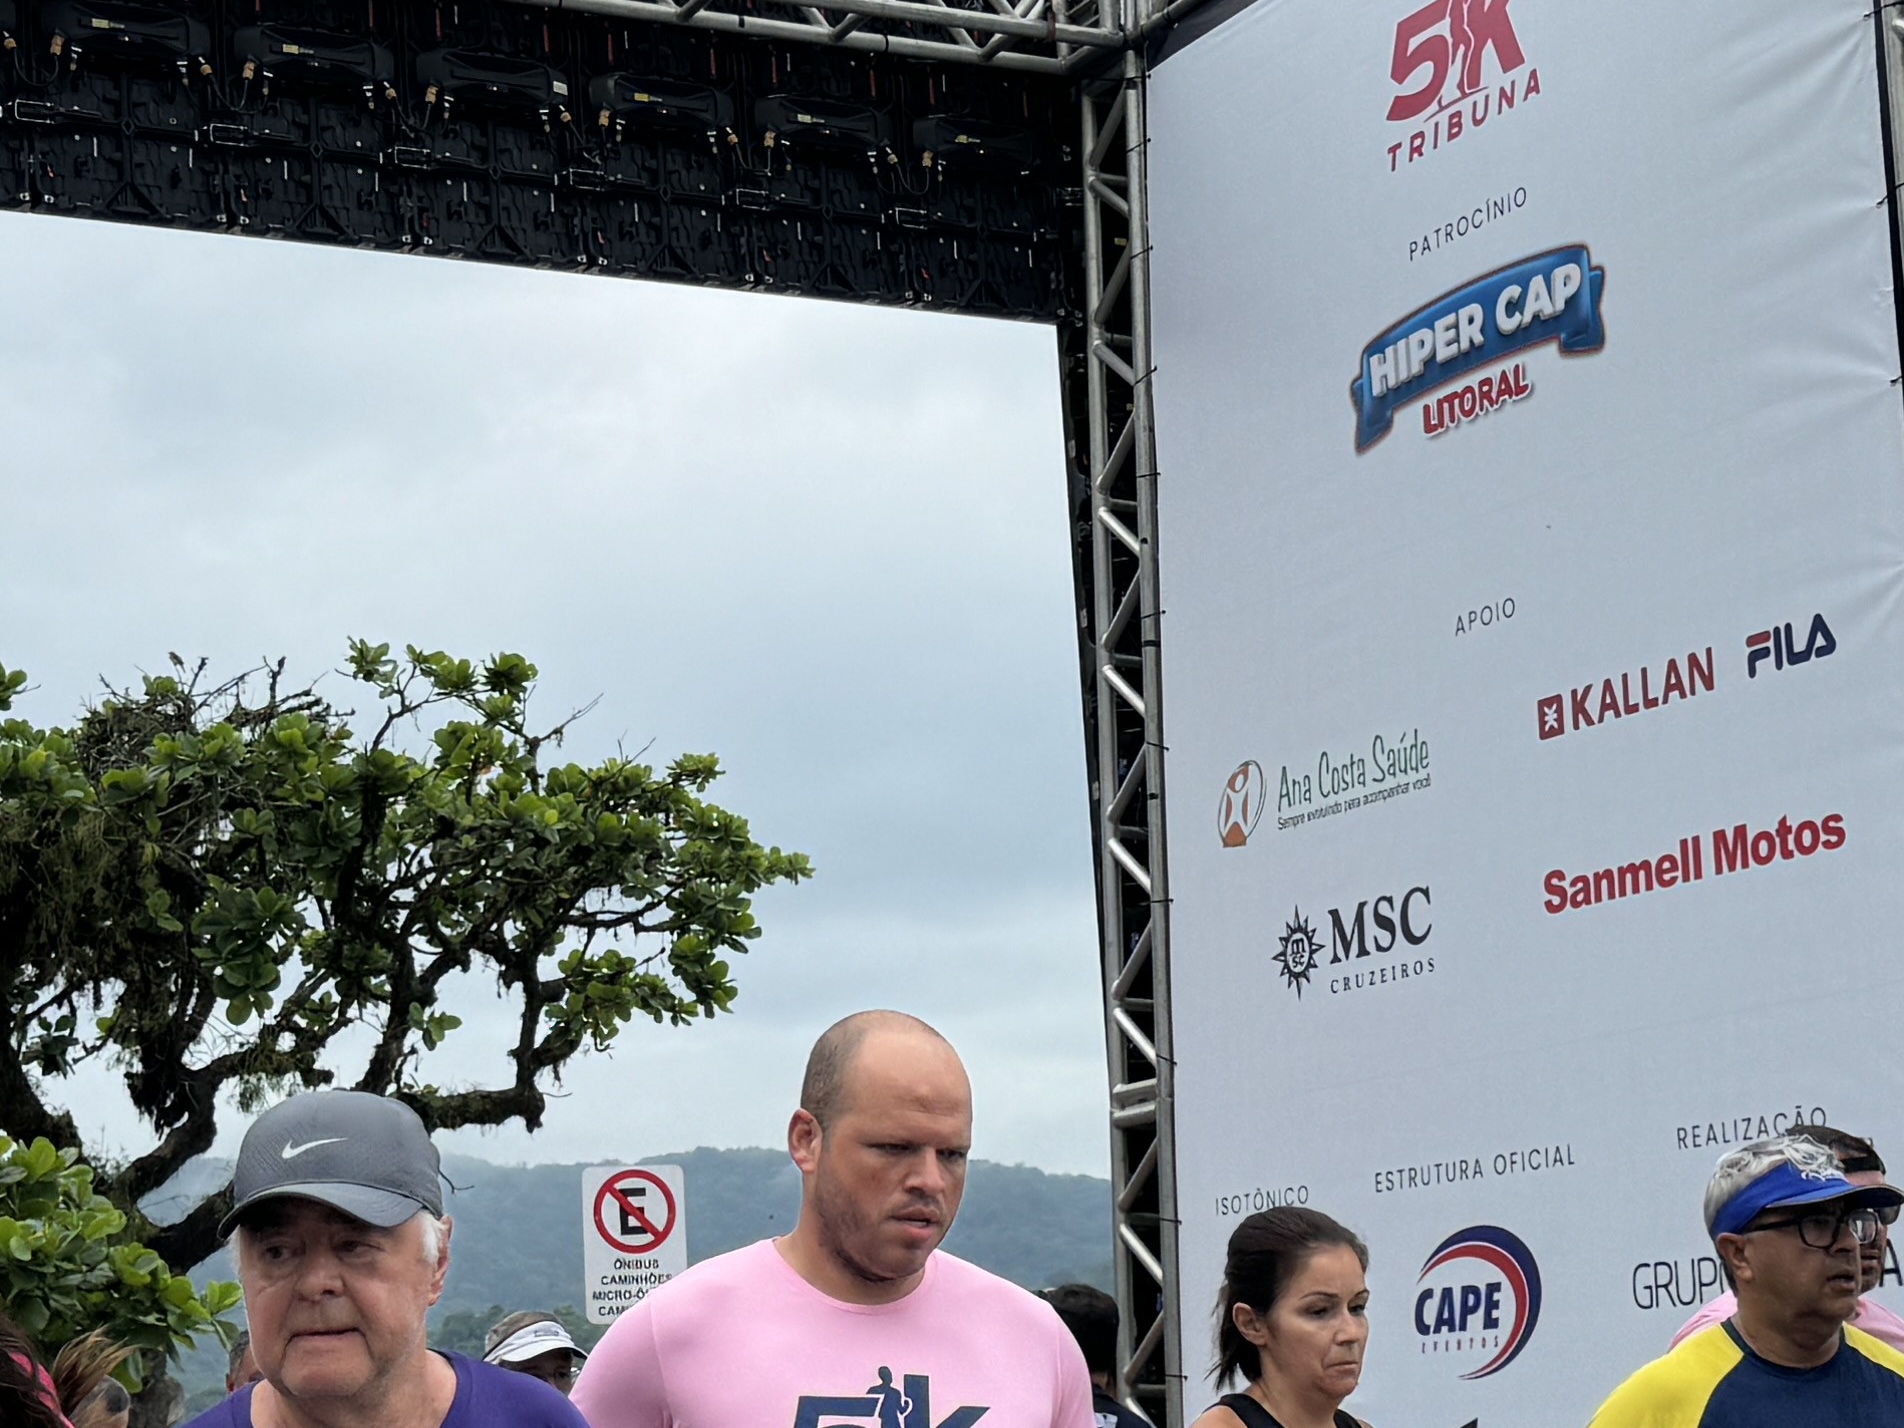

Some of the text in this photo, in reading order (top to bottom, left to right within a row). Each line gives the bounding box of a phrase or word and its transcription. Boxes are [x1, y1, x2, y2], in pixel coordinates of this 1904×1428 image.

[1387, 68, 1542, 172] TRIBUNA
[1408, 186, 1529, 261] PATROCÍNIO
[1367, 263, 1583, 397] HIPER CAP
[1422, 363, 1531, 435] LITORAL
[1454, 597, 1517, 637] APOIO
[1745, 613, 1838, 679] FILA
[1571, 647, 1715, 730] KALLAN
[1277, 728, 1431, 813] Ana Costa Saúde
[1543, 811, 1847, 916] Sanmell Motos
[1327, 885, 1433, 965] MSC
[1330, 957, 1436, 995] CRUZEIROS
[1215, 1185, 1309, 1216] ISOTÔNICO
[1374, 1143, 1576, 1193] ESTRUTURA OFICIAL
[1414, 1281, 1502, 1337] CAPE
